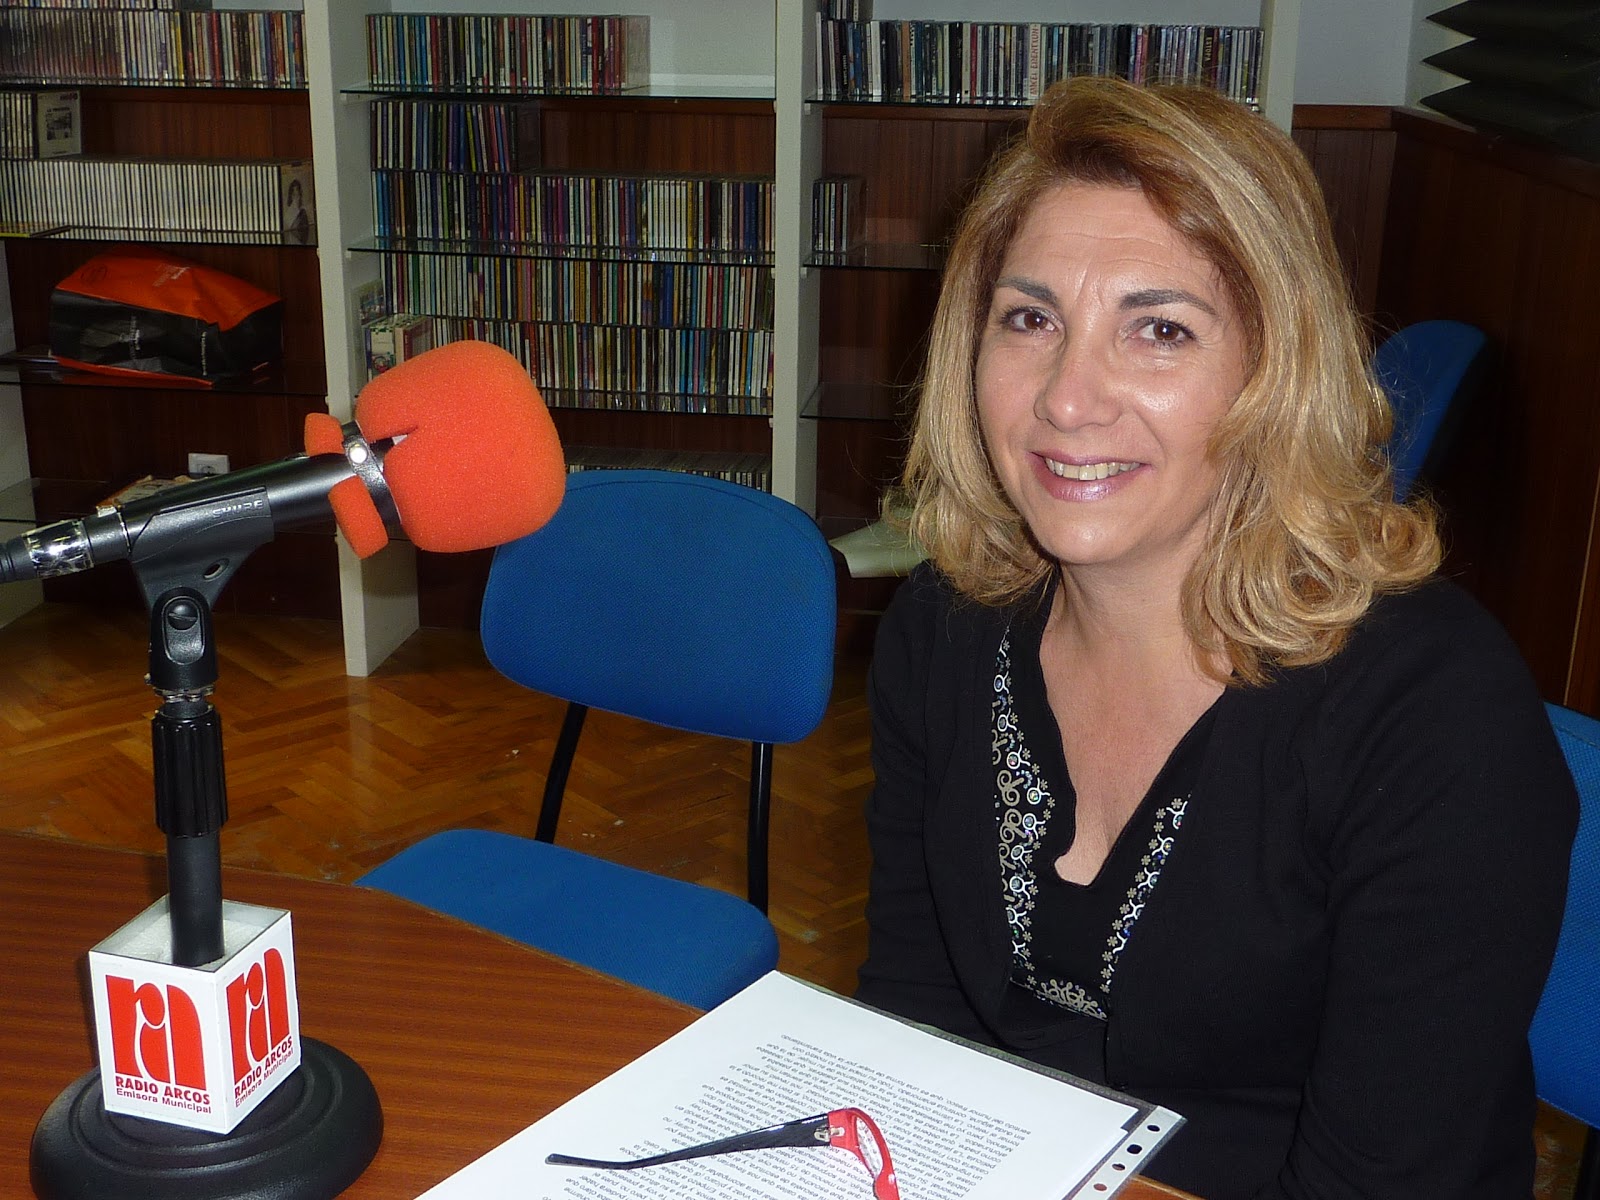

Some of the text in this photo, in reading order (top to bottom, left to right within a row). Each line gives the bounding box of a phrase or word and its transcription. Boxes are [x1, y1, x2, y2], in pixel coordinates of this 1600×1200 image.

[1205, 37, 1213, 61] ESTOPA
[1029, 73, 1040, 96] MIKEL
[212, 499, 264, 518] SHURE
[234, 1035, 293, 1099] RADIO ARCOS
[235, 1048, 294, 1108] Emisora Municipal
[115, 1076, 211, 1105] RADIO ARCOS
[116, 1089, 212, 1114] Emisora Municipal
